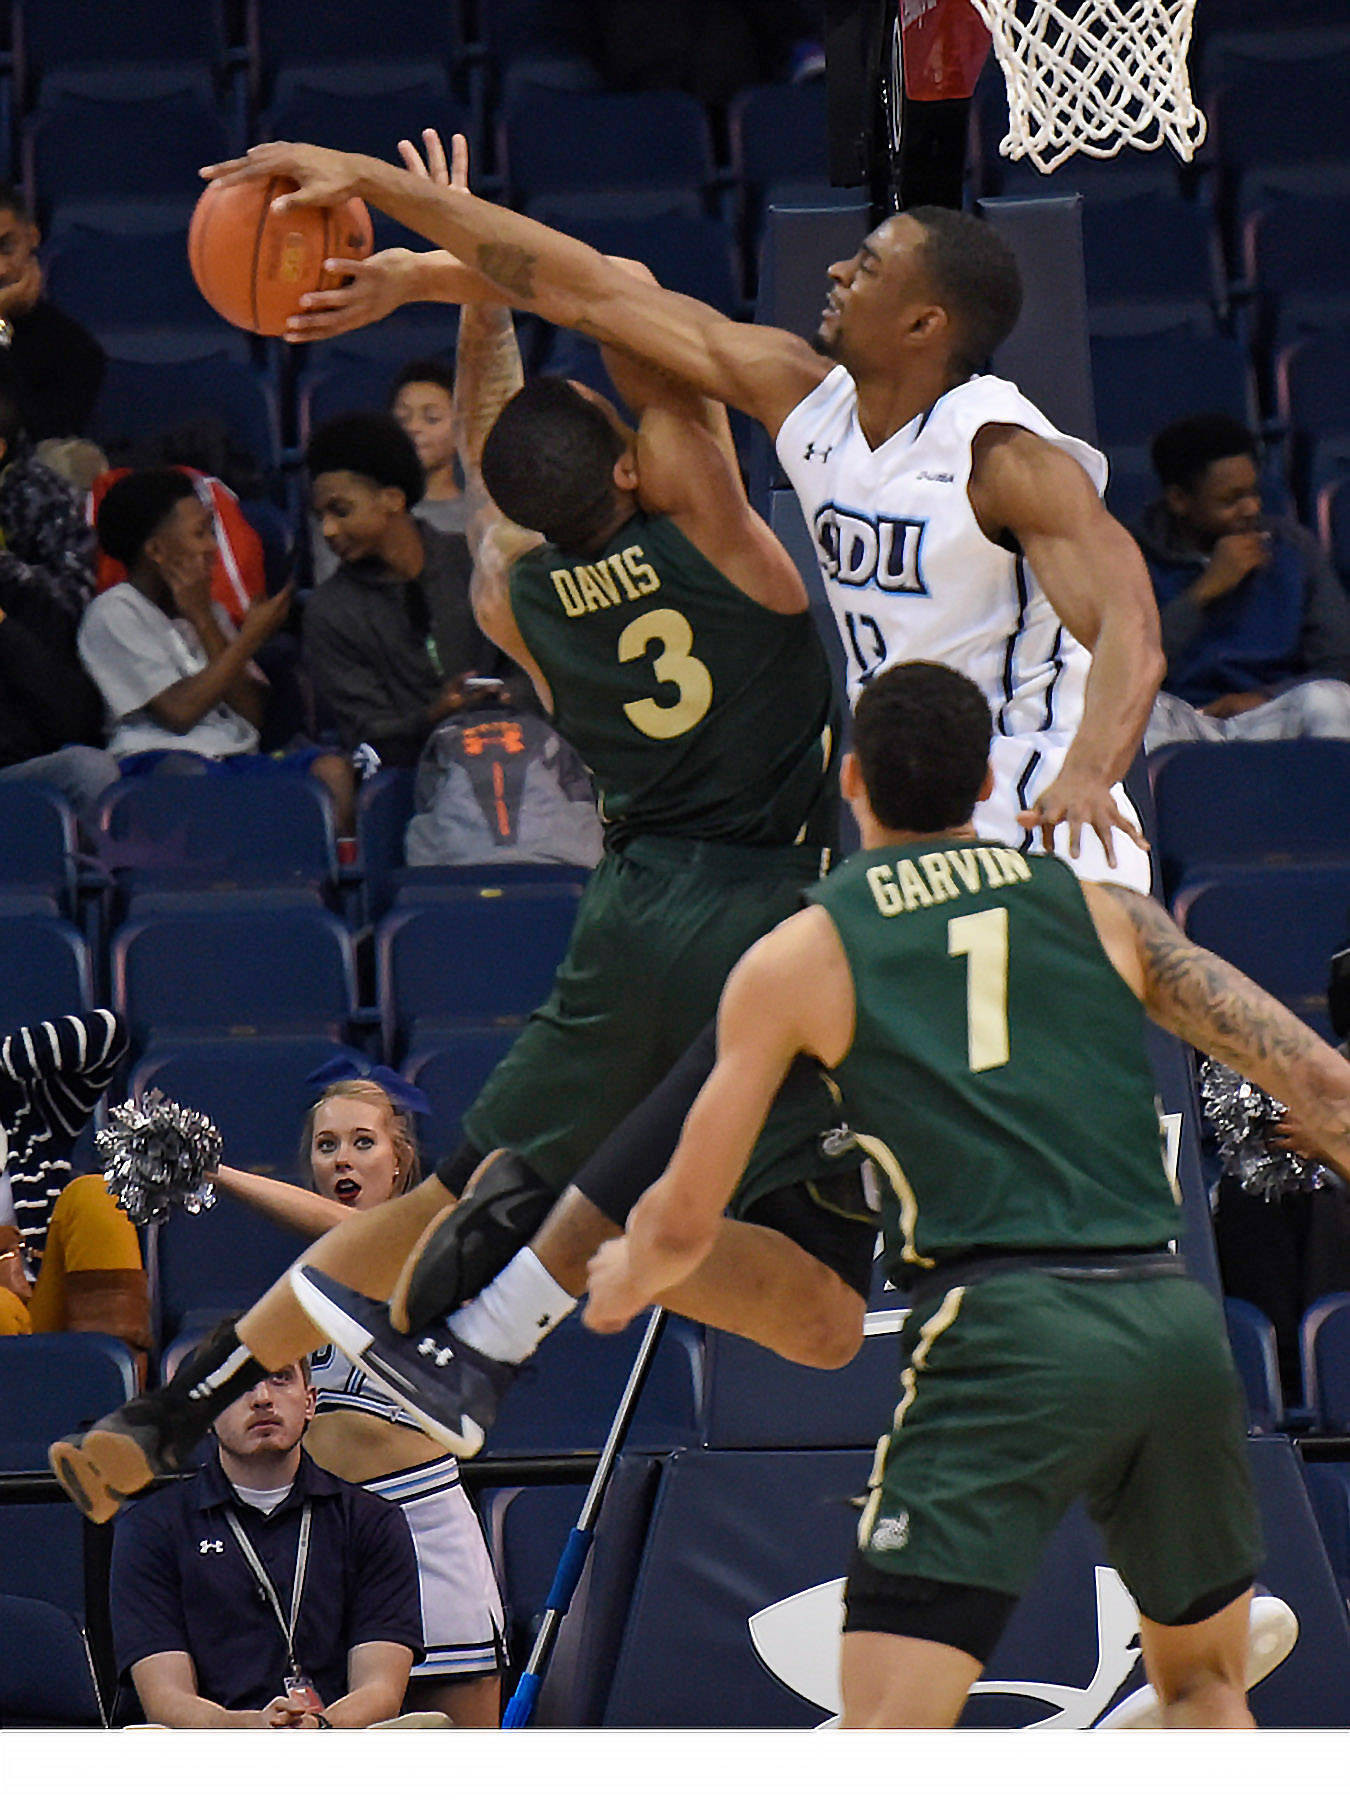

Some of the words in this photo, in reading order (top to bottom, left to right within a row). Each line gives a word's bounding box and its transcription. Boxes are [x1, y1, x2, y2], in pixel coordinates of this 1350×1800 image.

[550, 545, 661, 617] DAVIS
[814, 502, 931, 597] ODU
[618, 608, 713, 739] 3
[866, 847, 1032, 917] GARVIN
[947, 907, 1010, 1073] 1
